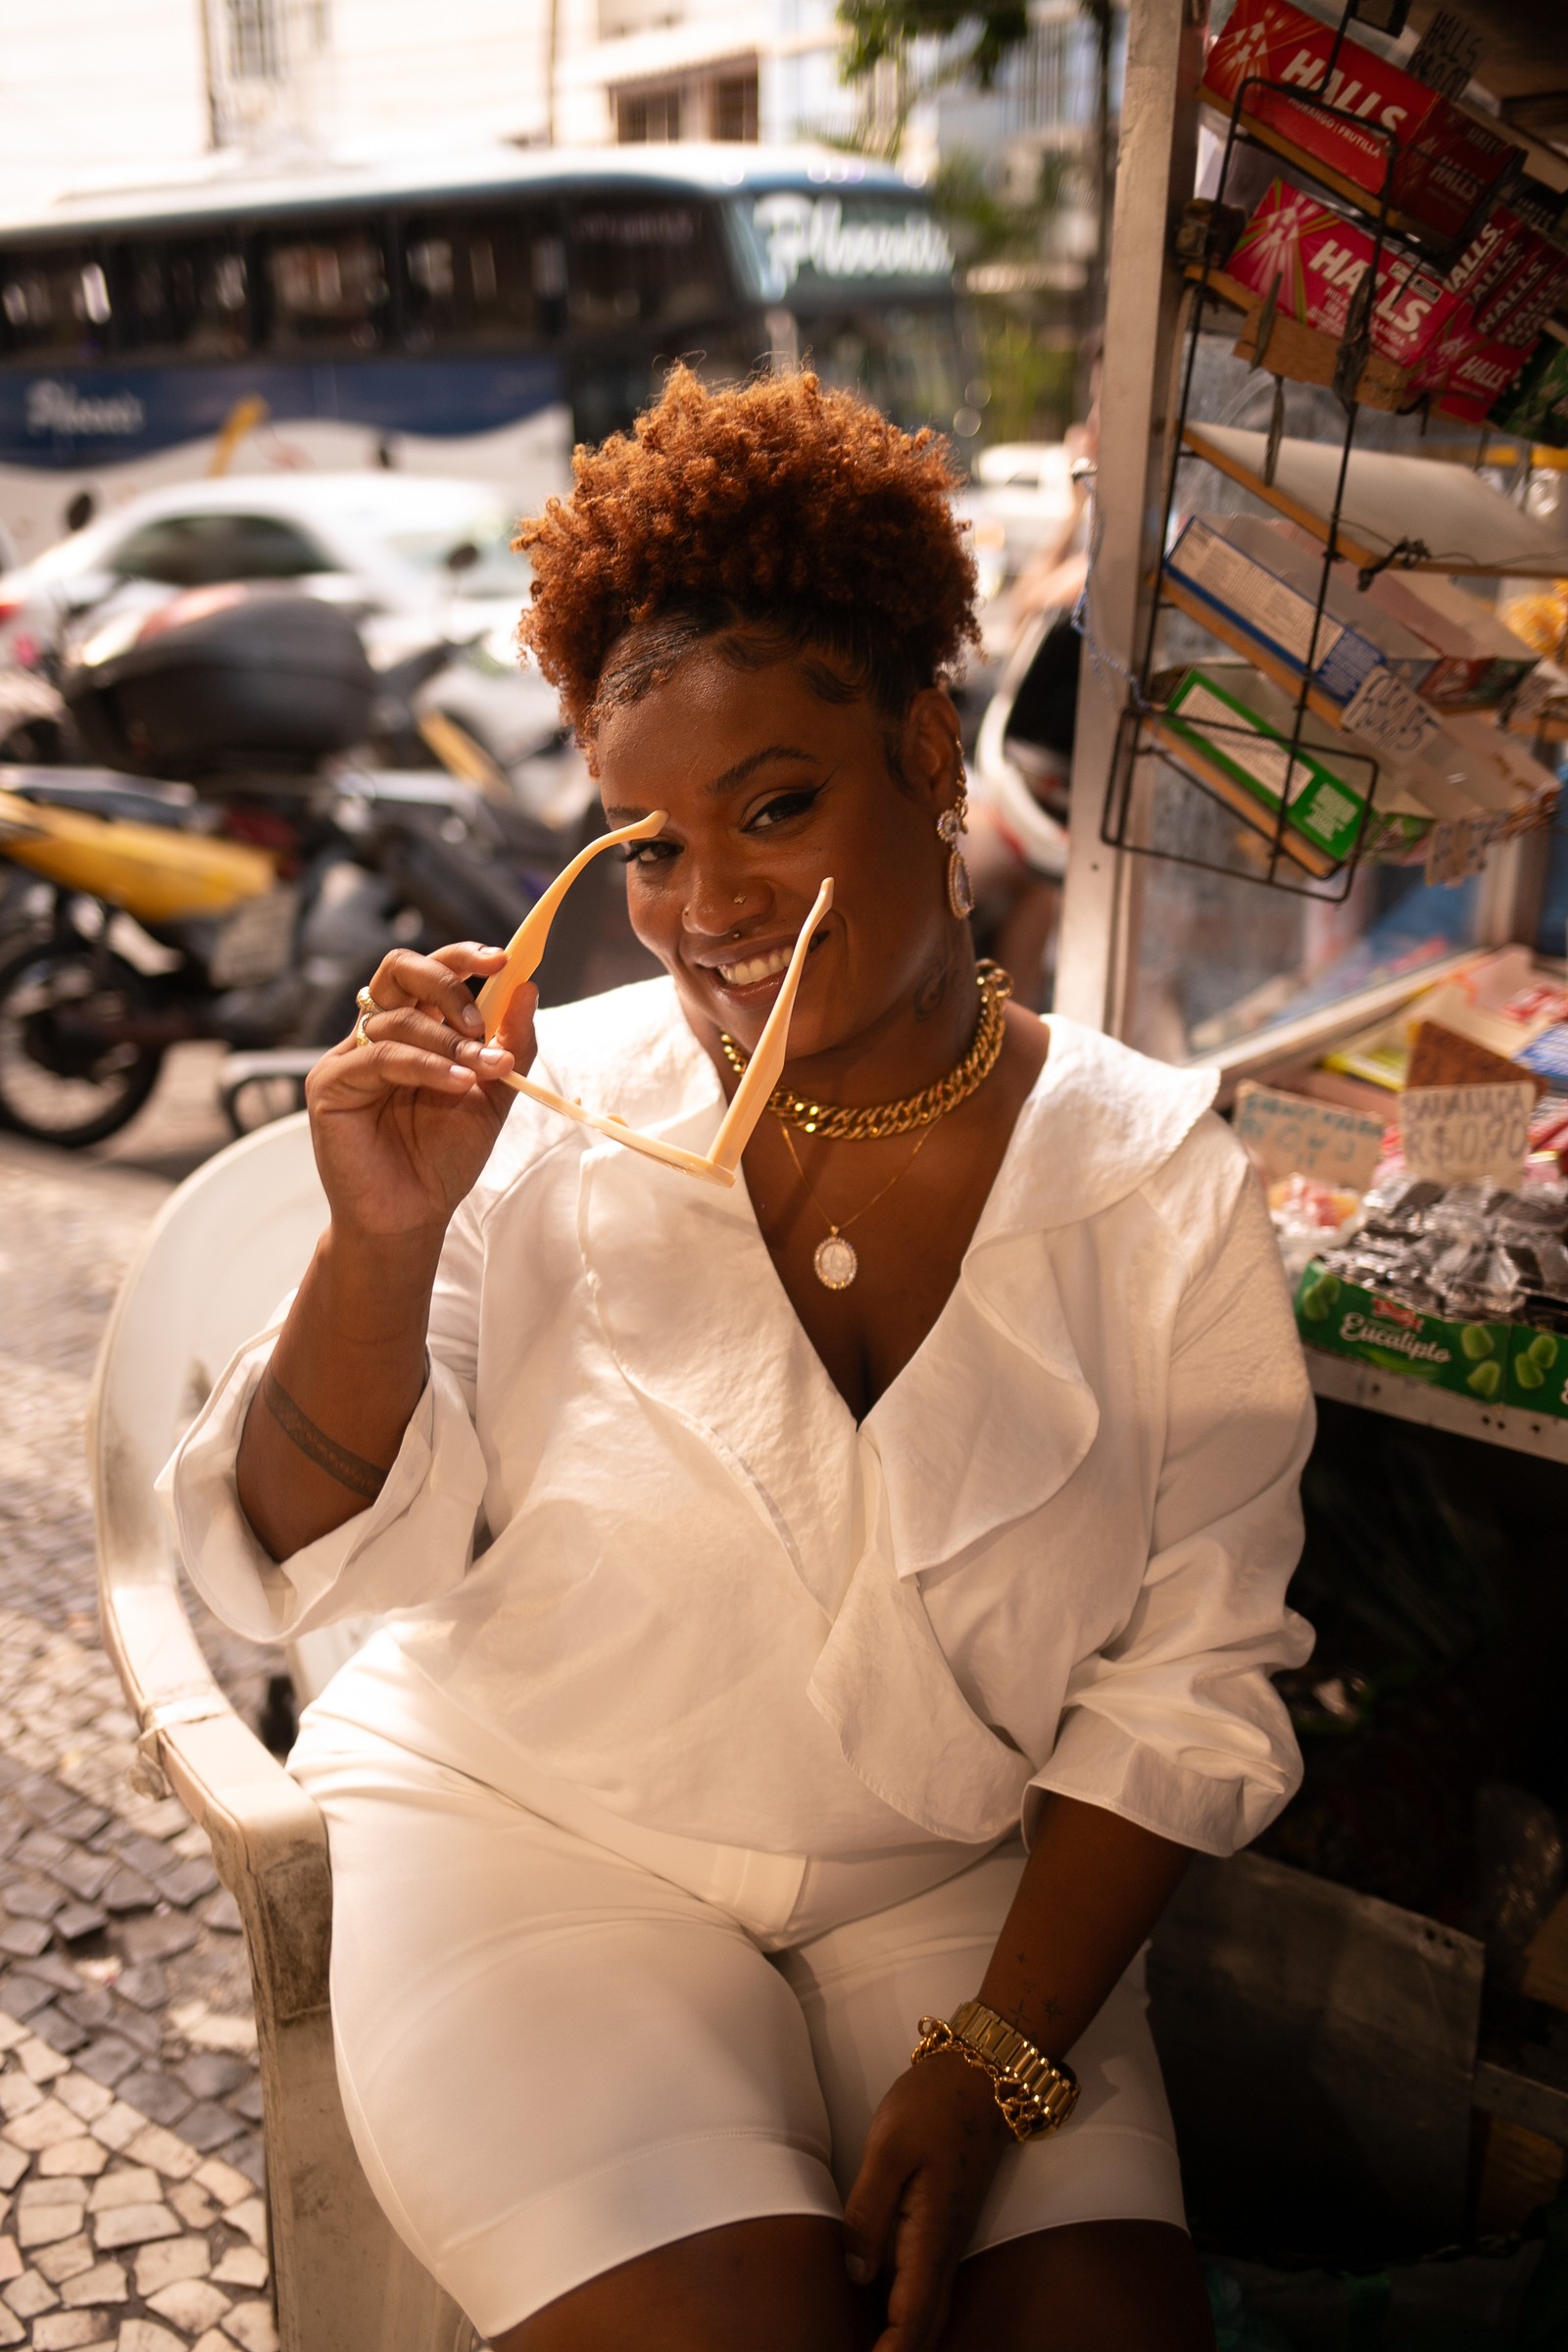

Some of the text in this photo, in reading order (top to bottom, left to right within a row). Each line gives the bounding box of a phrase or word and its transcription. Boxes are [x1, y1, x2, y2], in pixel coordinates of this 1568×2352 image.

[1279, 48, 1408, 139] HALLS
[1338, 124, 1382, 159] FRUTILLA
[1307, 238, 1433, 332] HALS
[1477, 262, 1545, 334] HALLS
[1455, 355, 1512, 393] HALLS
[1339, 1312, 1451, 1363] Eucalipto
